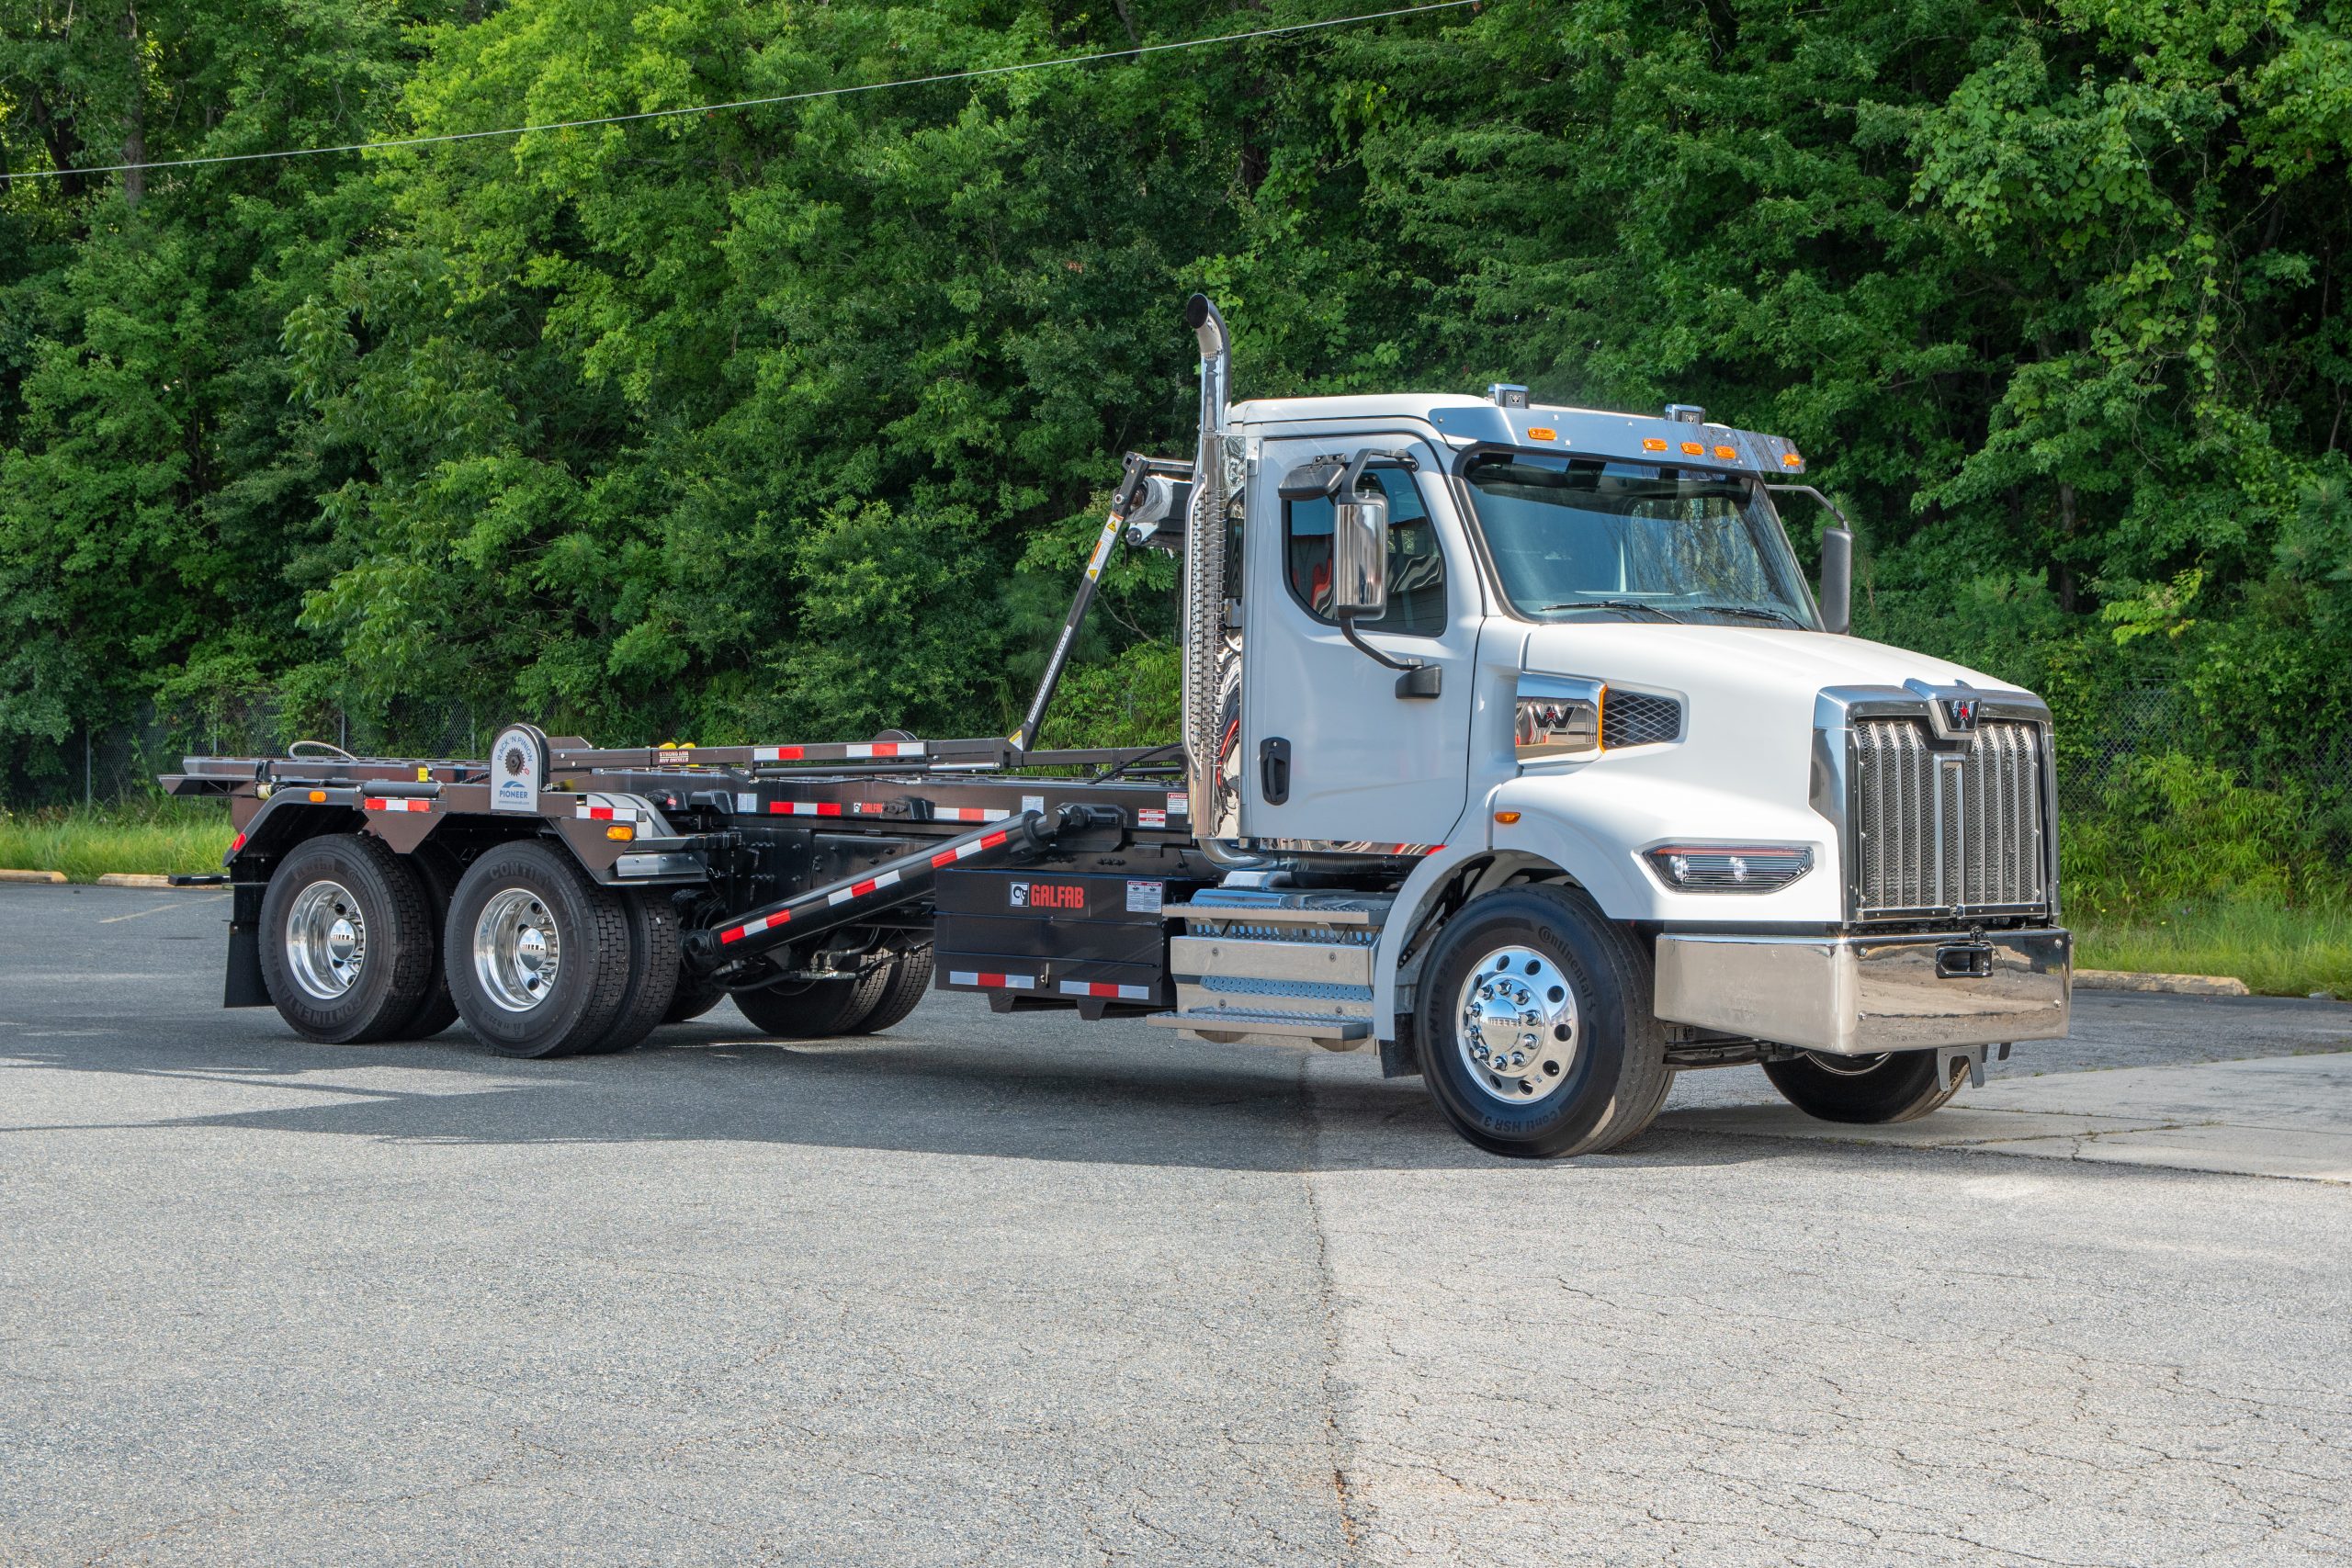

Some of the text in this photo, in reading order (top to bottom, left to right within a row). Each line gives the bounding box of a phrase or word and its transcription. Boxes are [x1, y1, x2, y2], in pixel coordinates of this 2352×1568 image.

[1528, 705, 1577, 729] W
[497, 739, 511, 761] RACK
[517, 736, 533, 761] PINION
[499, 790, 528, 799] PIONEER
[862, 802, 882, 813] GALFA
[489, 863, 572, 933] CONTINAL
[1031, 884, 1084, 908] GALFAB
[1538, 925, 1593, 998] Continental
[1483, 1108, 1559, 1133] Conti HSR 3
